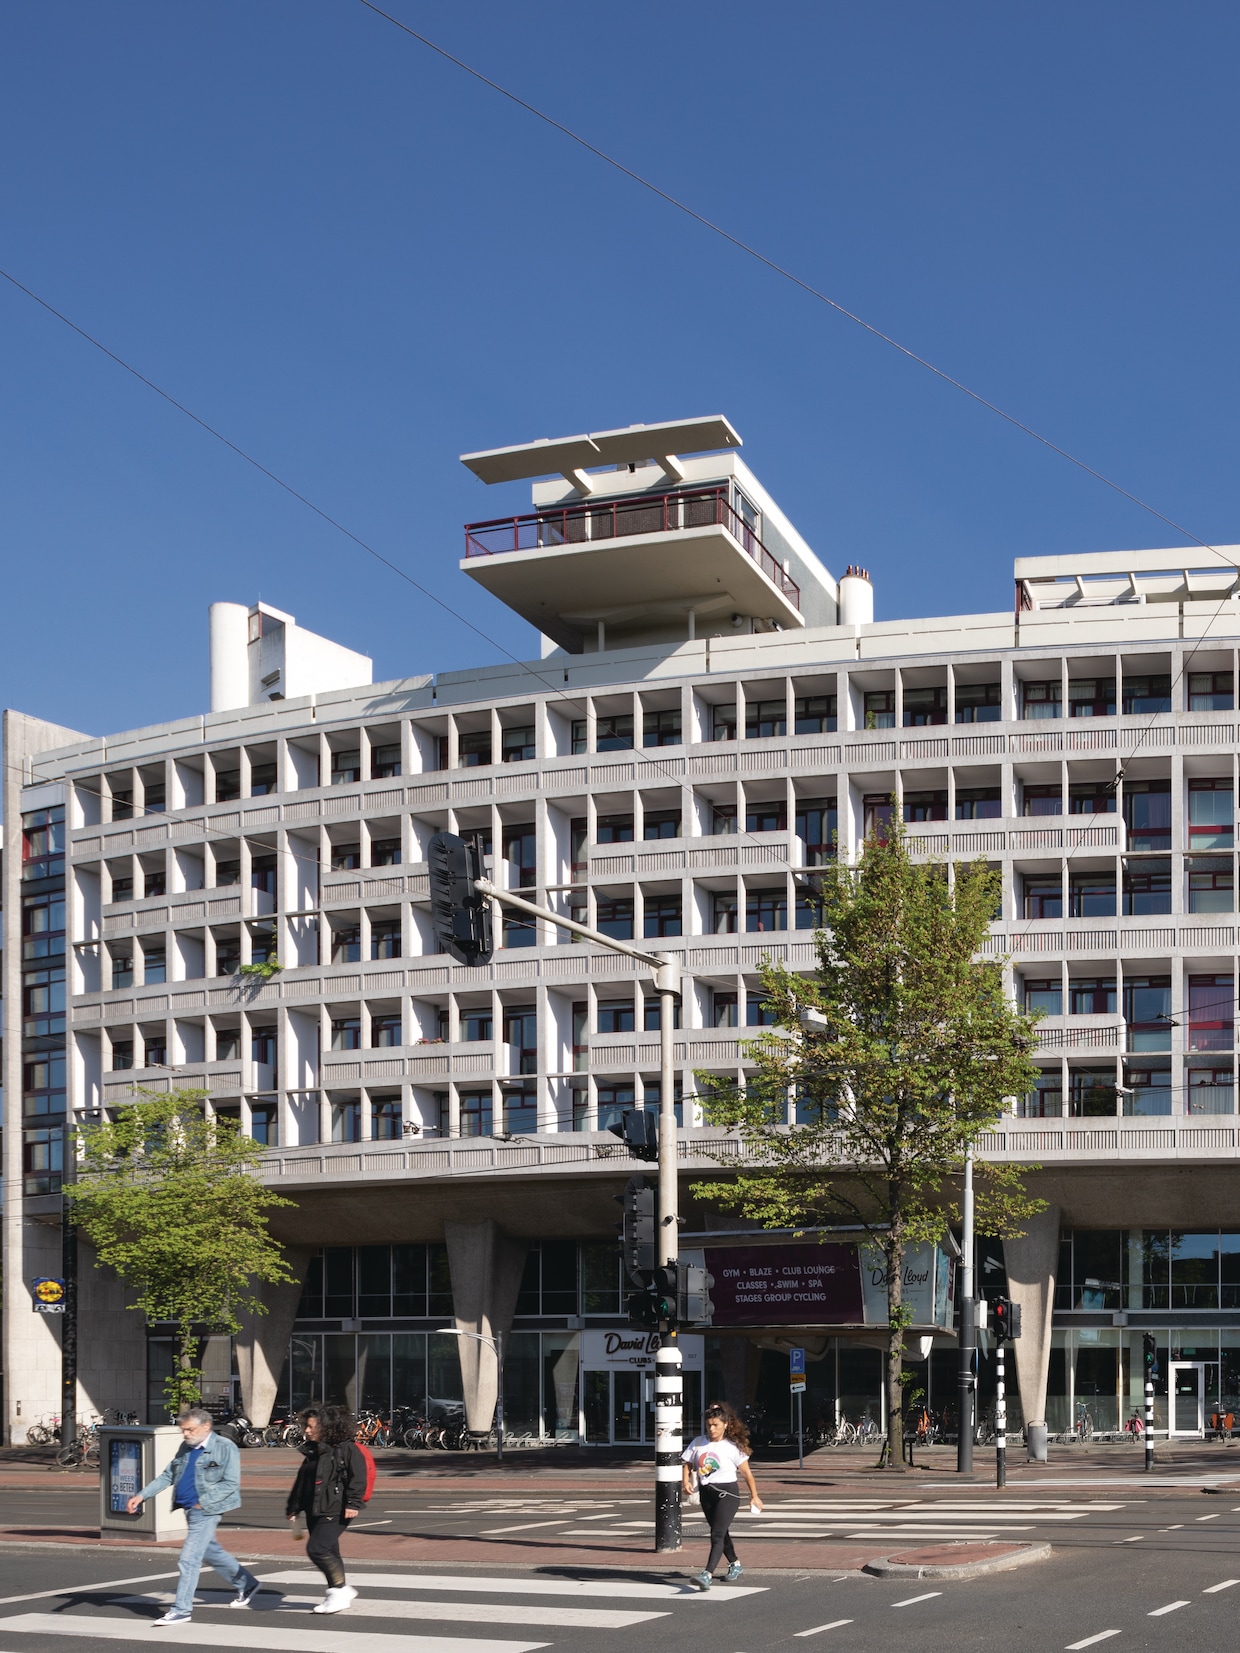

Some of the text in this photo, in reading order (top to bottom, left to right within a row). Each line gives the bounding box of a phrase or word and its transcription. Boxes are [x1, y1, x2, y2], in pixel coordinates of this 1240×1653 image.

[723, 1265, 836, 1277] GYM BLAZE CLUB LOUNGE
[903, 1266, 929, 1286] Lloyd
[736, 1279, 823, 1290] CLASSES SWIM SPA
[735, 1292, 827, 1303] STAGES GROUP CYCLING
[604, 1332, 645, 1354] David
[793, 1351, 801, 1363] P
